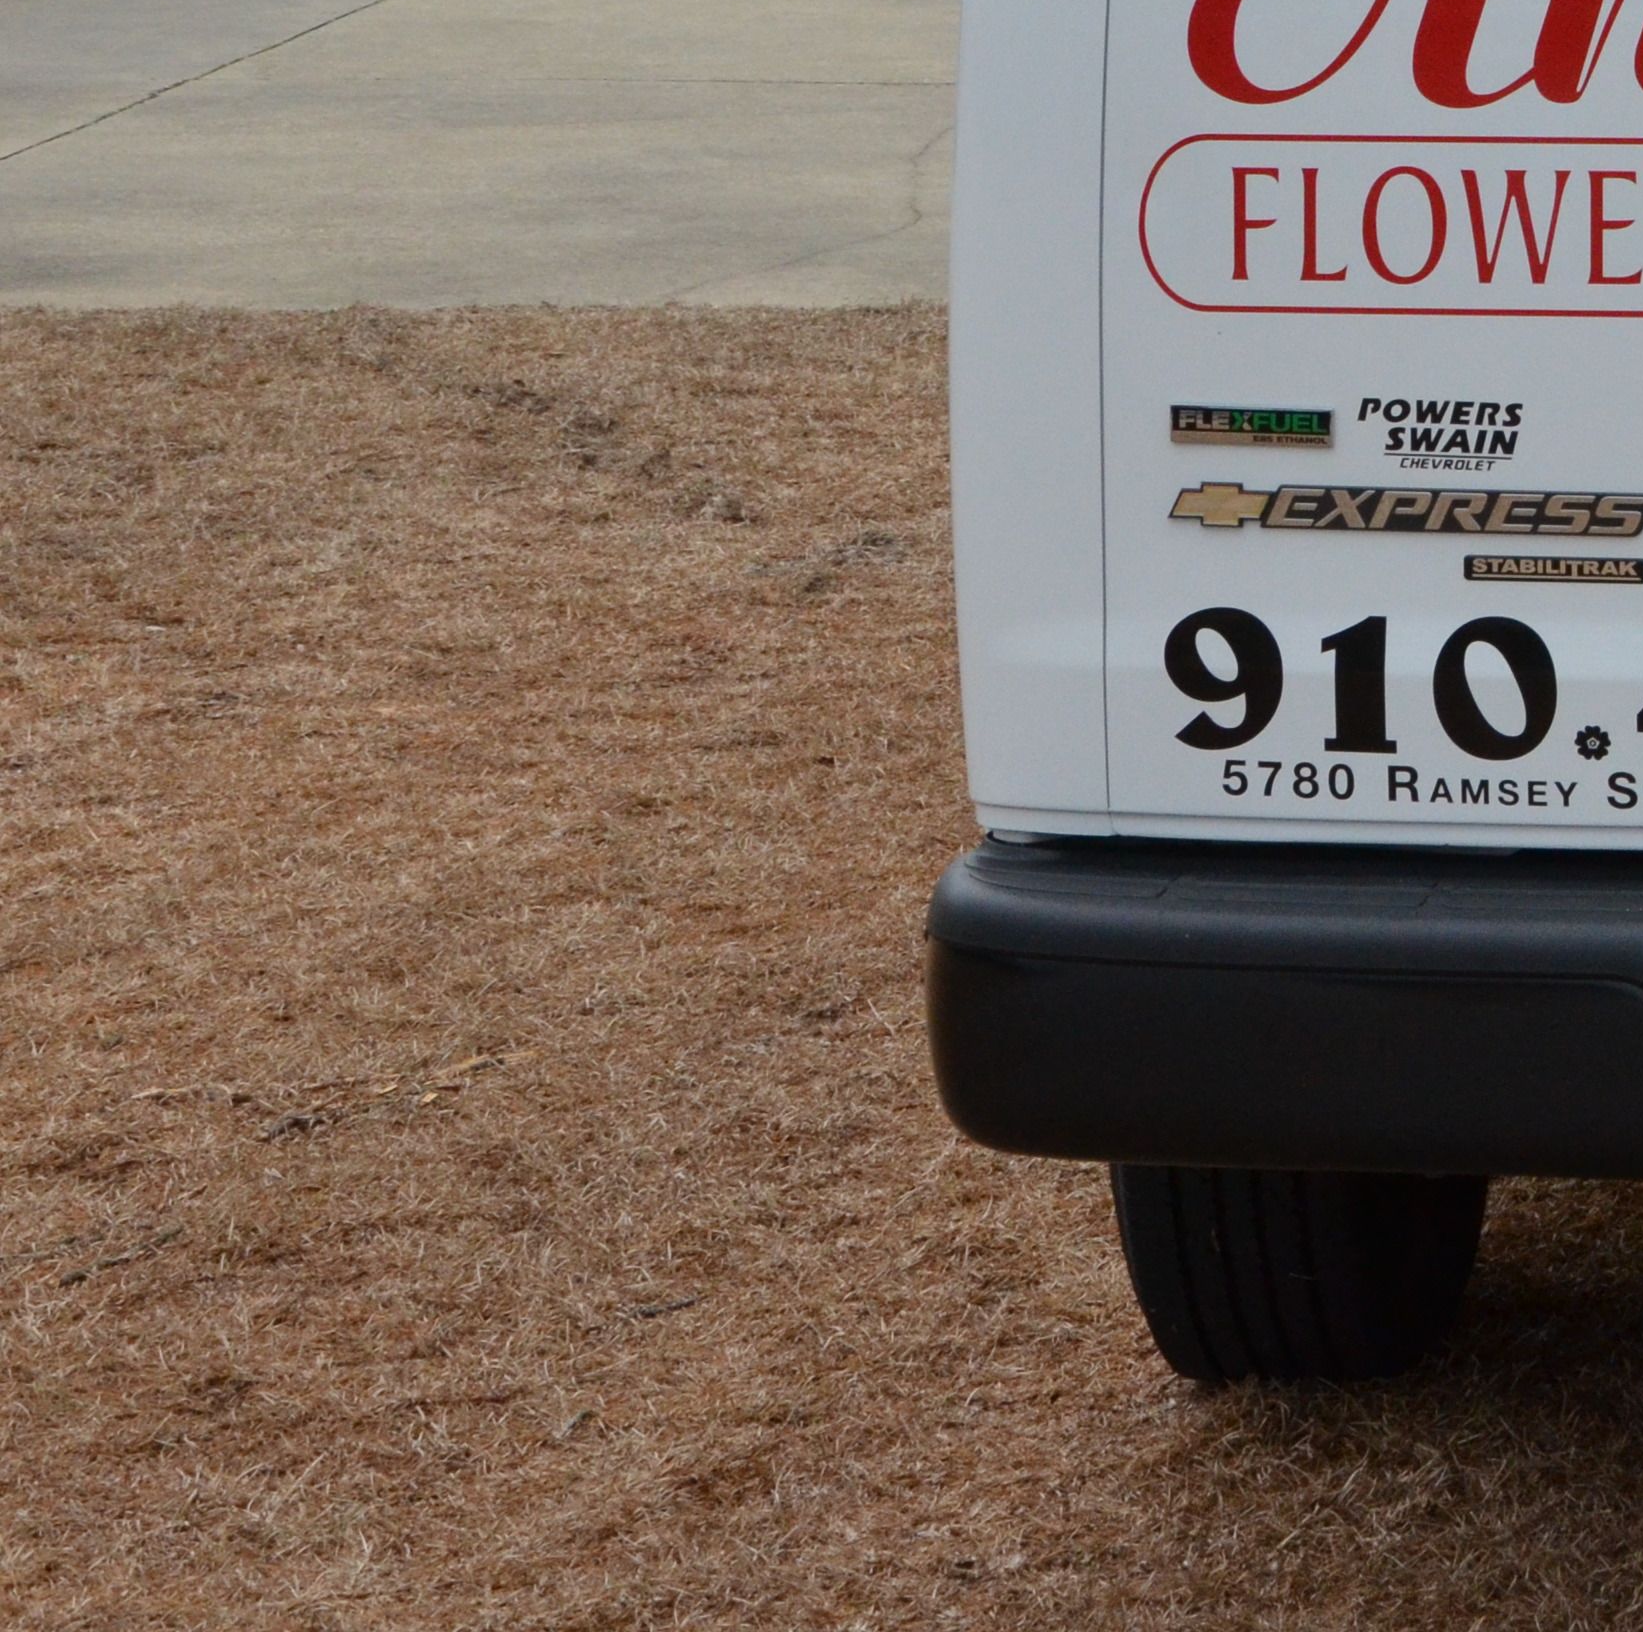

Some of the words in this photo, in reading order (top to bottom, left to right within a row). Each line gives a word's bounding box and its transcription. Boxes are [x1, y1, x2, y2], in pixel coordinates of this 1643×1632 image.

[1358, 398, 1523, 427] POWERS
[1276, 435, 1329, 445] ETHANOL
[1385, 426, 1519, 455] SWAIN
[1399, 457, 1497, 472] CHEVROLET
[1472, 557, 1638, 578] STABILITRAK
[1222, 759, 1355, 800] 5780
[1387, 765, 1578, 808] RAMSEY
